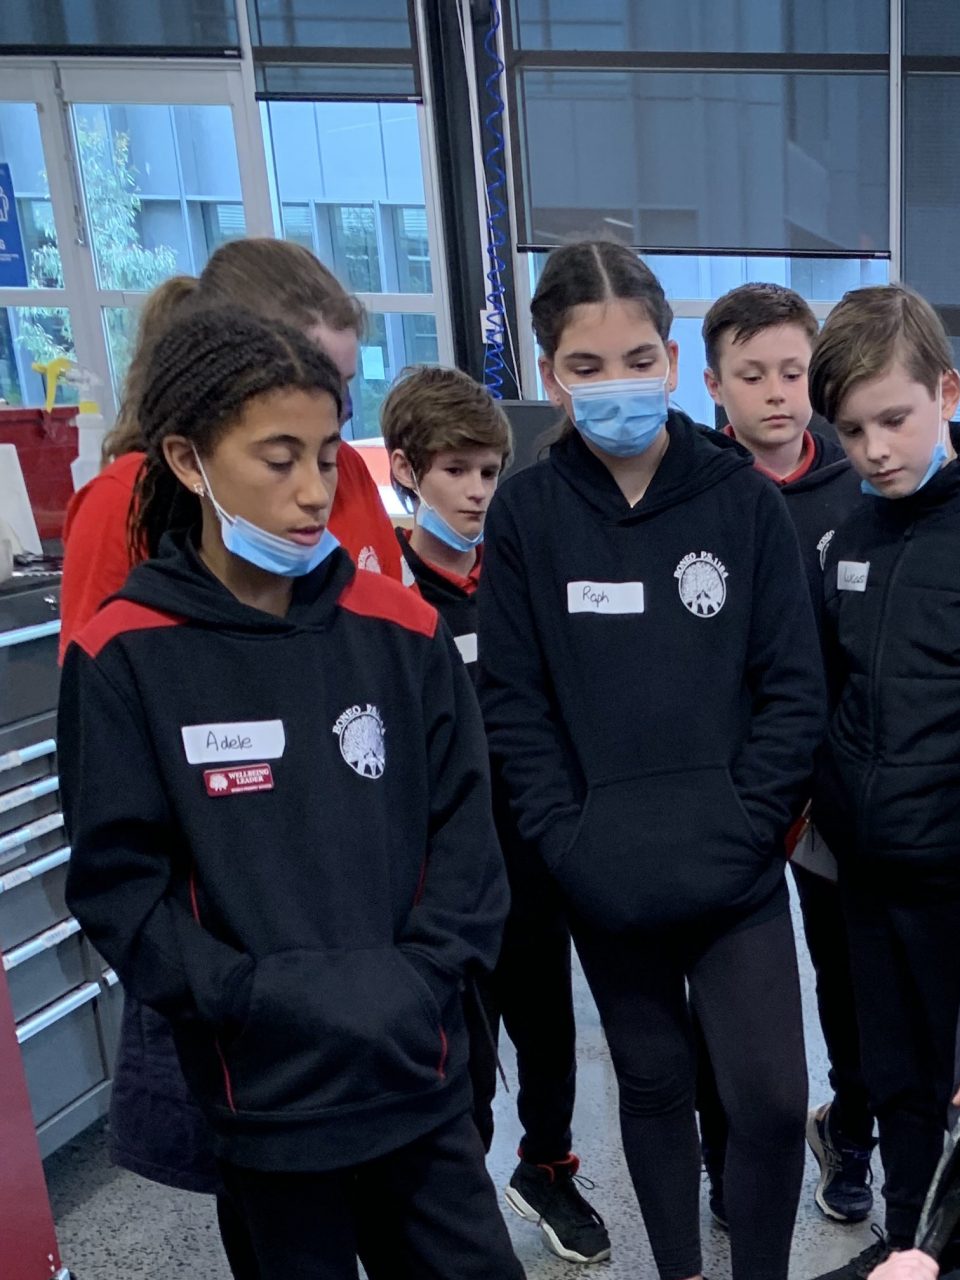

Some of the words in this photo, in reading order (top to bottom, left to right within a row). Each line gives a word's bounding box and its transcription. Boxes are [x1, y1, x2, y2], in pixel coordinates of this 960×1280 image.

[673, 552, 697, 578] BONEO
[582, 585, 609, 608] Raph
[332, 705, 361, 735] BONEO
[206, 730, 253, 751] Adele
[228, 767, 270, 780] WELLBEING
[236, 775, 265, 785] LEADER
